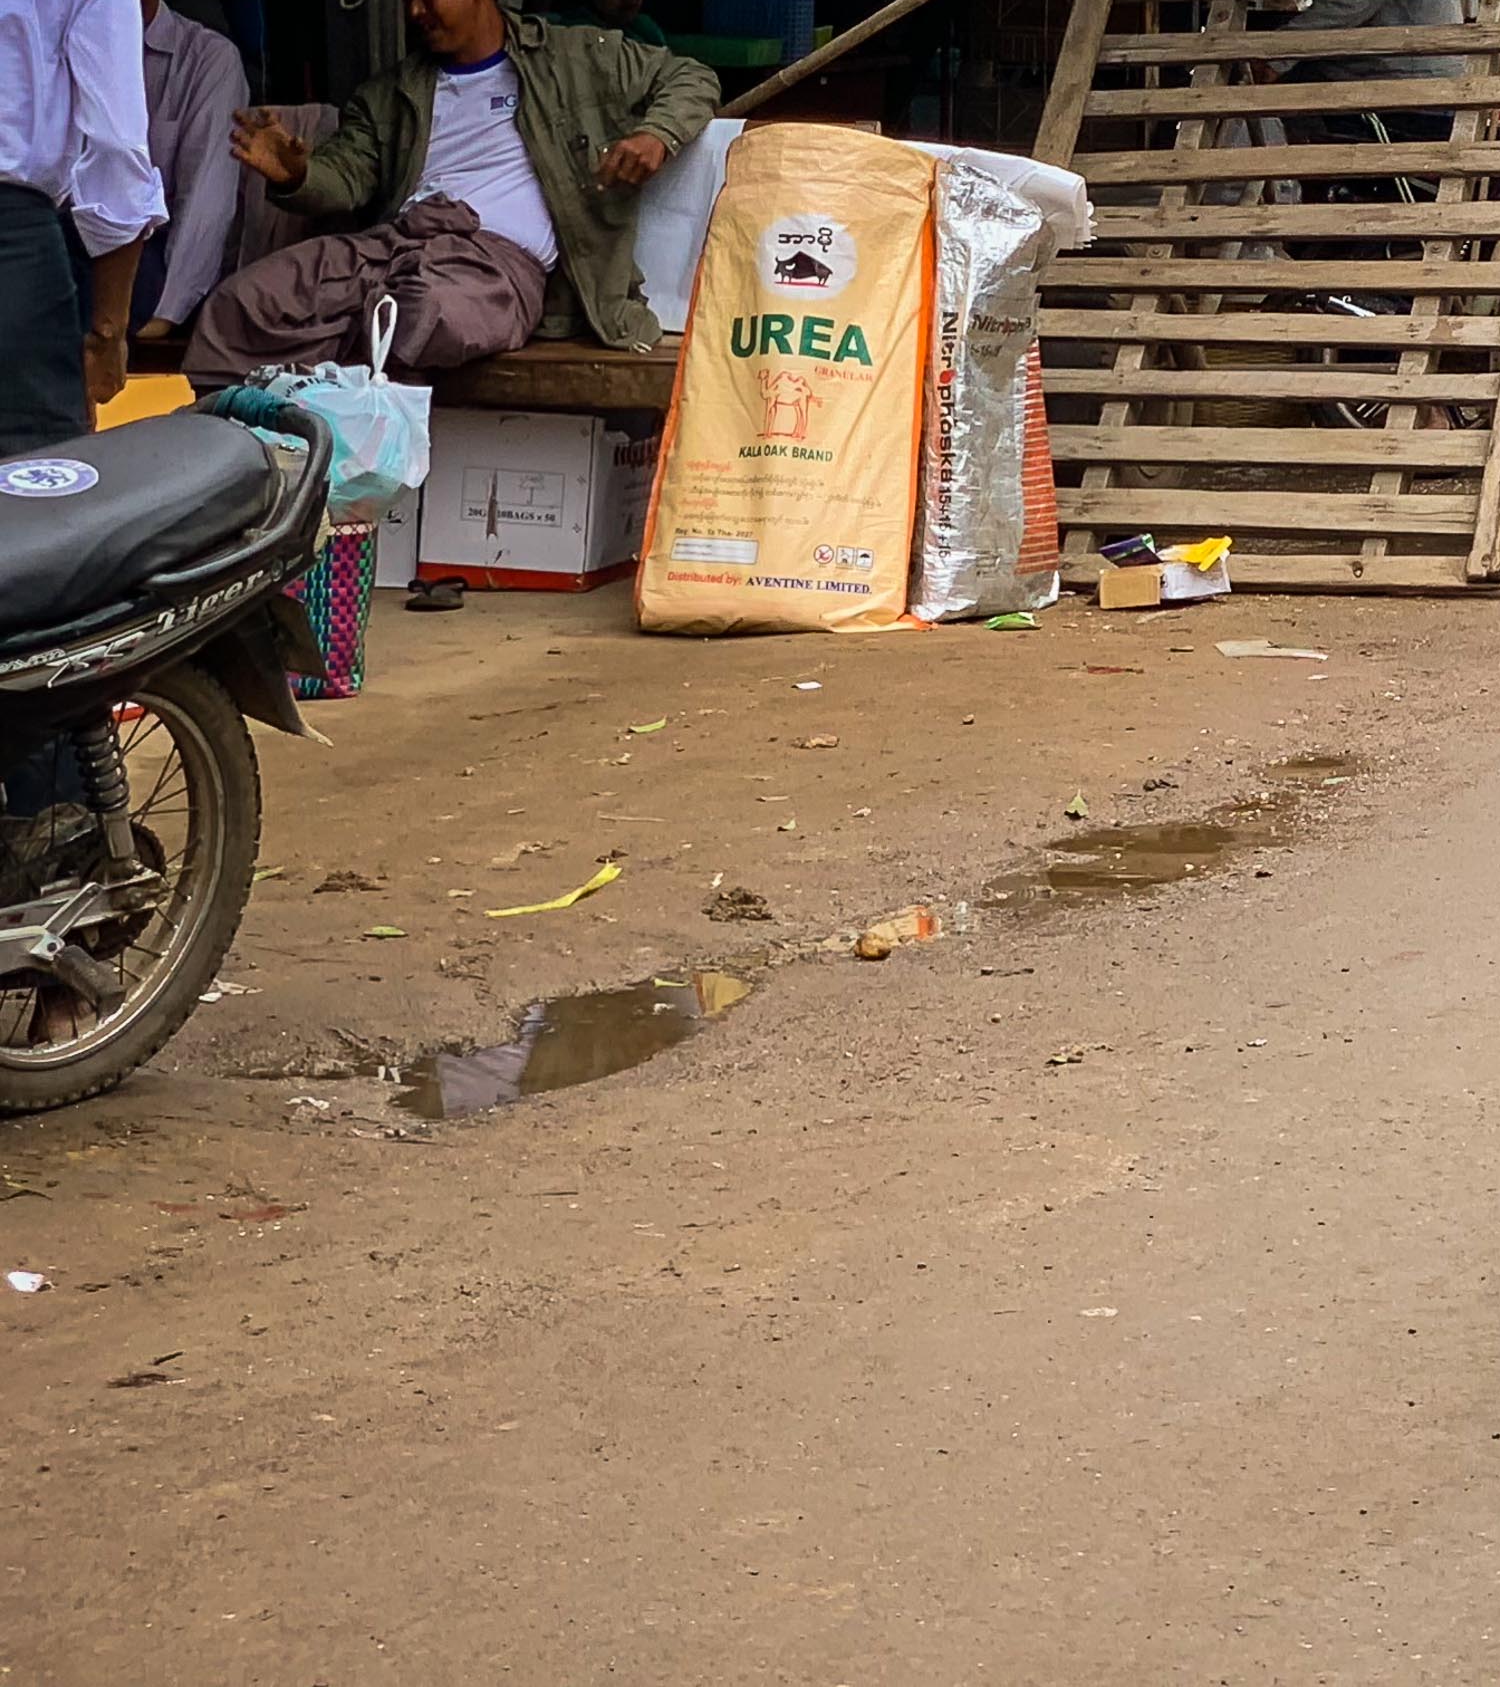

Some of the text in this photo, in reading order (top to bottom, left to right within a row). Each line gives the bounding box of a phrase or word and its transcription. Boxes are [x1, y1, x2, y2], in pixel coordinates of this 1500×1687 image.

[731, 313, 874, 367] UREA
[814, 365, 875, 383] GRANULAR
[738, 444, 834, 463] KALA OAK BRAND
[667, 570, 873, 595] Distributed by: AVENTINE LIMITED.
[156, 569, 265, 637] Tiger
